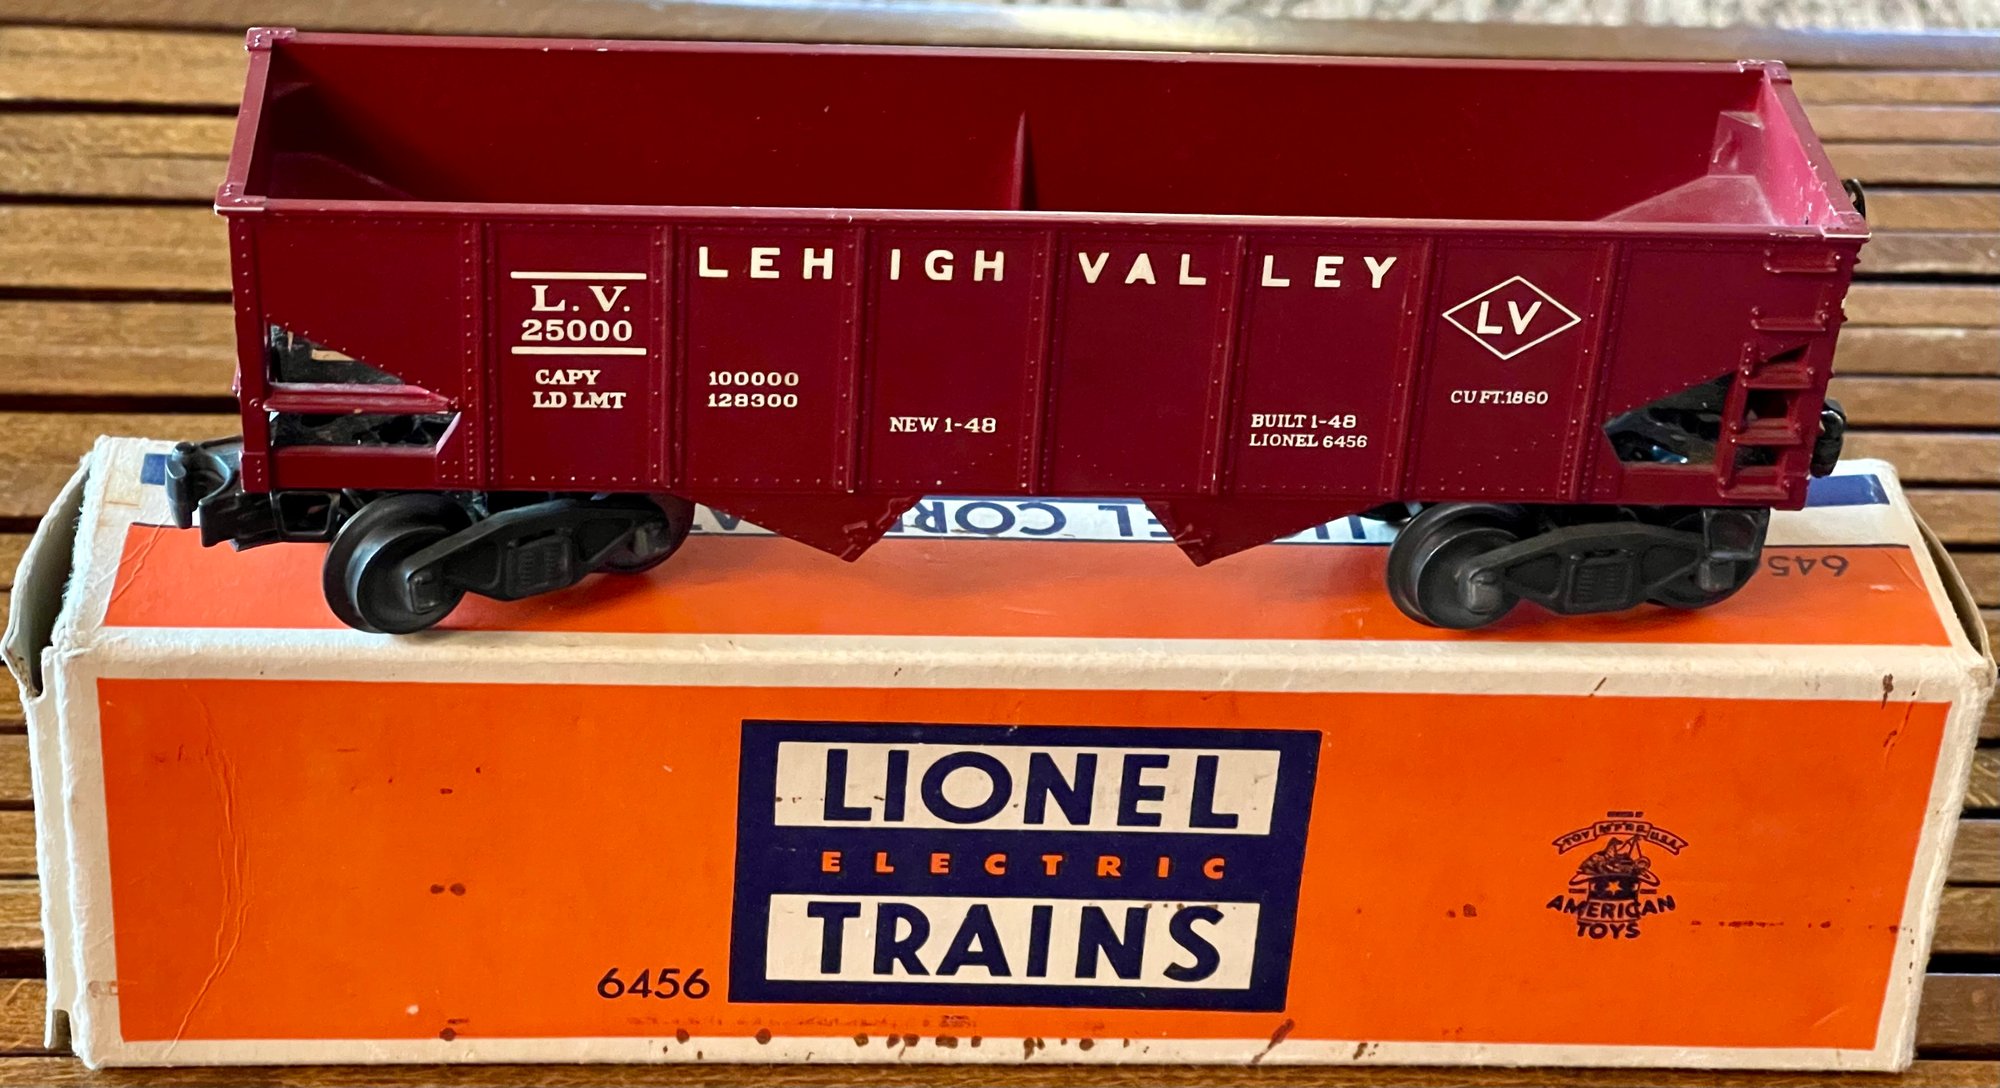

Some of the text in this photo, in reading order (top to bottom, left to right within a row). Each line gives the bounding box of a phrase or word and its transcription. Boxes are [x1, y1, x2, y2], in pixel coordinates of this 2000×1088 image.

[698, 246, 1398, 289] LEHIGH VALLEY
[1476, 300, 1542, 335] LV
[521, 318, 633, 342] 25000
[535, 369, 799, 387] CAPY 100000
[532, 391, 798, 409] LD LMT 128300
[1450, 390, 1478, 404] CU
[889, 416, 997, 433] NEW 1-48
[1250, 413, 1357, 429] BUILT 1-48
[1248, 433, 1368, 449] LIONEL 6456
[1767, 555, 1849, 577] 645
[822, 749, 1239, 828] LIONEL
[822, 851, 1225, 880] ELECTRIC
[1546, 894, 1677, 919] AMERICAN
[807, 901, 1225, 982] TRAINS
[1576, 921, 1641, 940] TOYS
[597, 967, 710, 999] 6456
